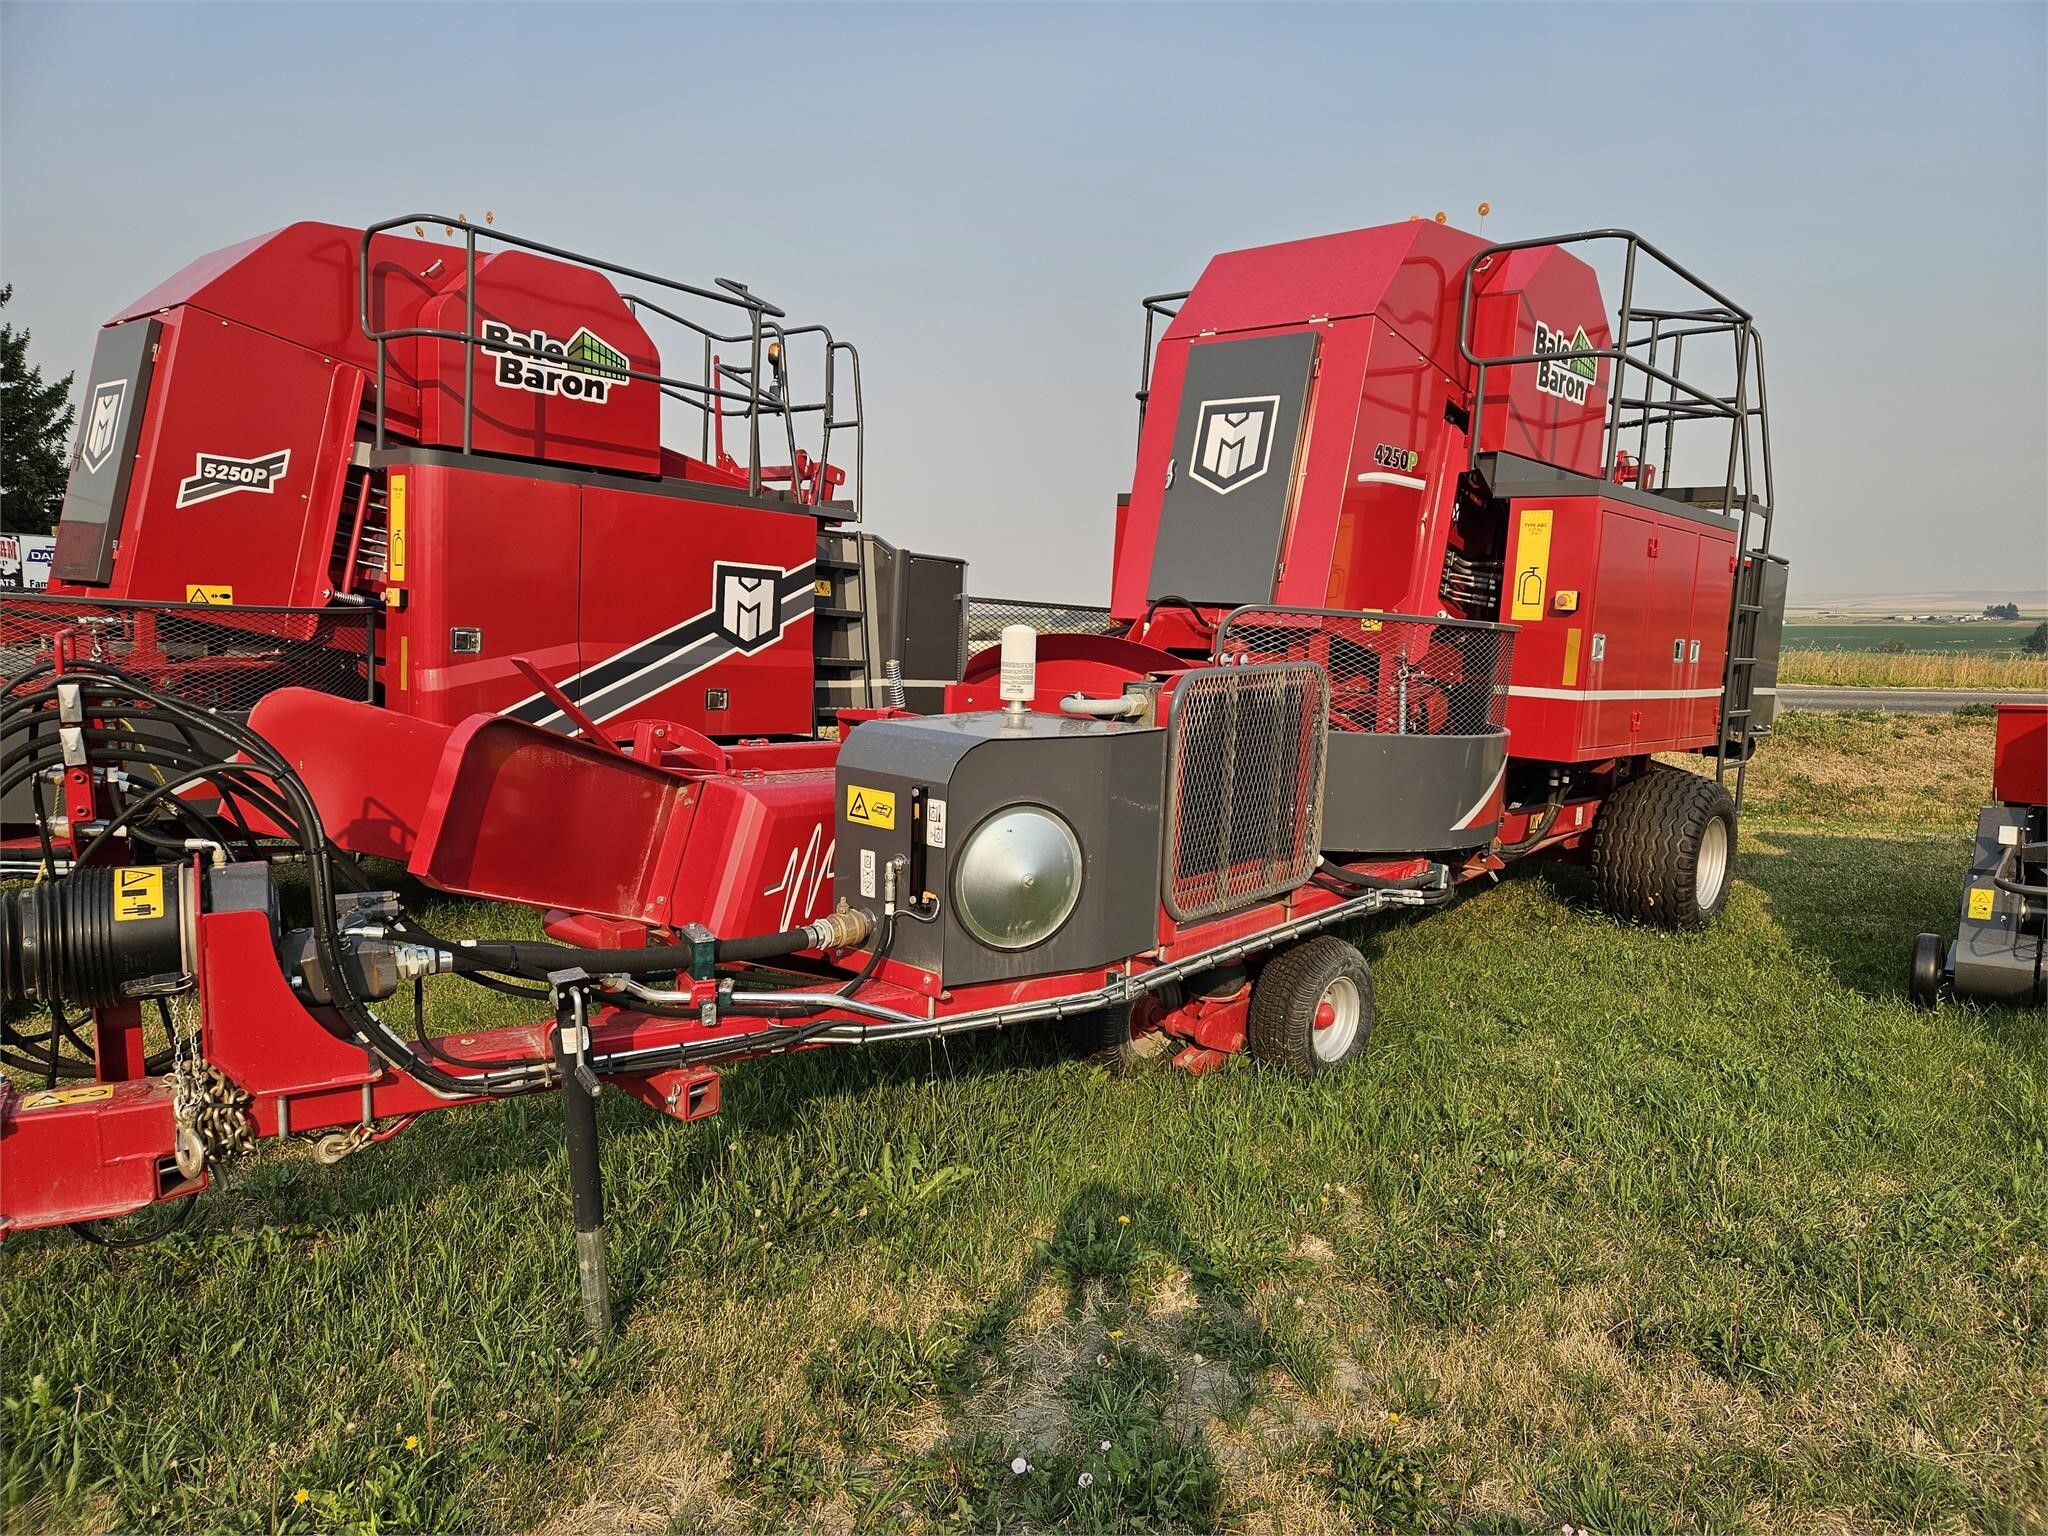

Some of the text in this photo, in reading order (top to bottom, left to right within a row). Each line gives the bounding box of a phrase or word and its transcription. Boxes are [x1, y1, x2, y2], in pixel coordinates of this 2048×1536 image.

[486, 324, 564, 365] Bale
[500, 356, 604, 400] Baron
[1538, 360, 1585, 401] Baron
[203, 462, 268, 484] 5250P
[1374, 444, 1418, 472] 4250P
